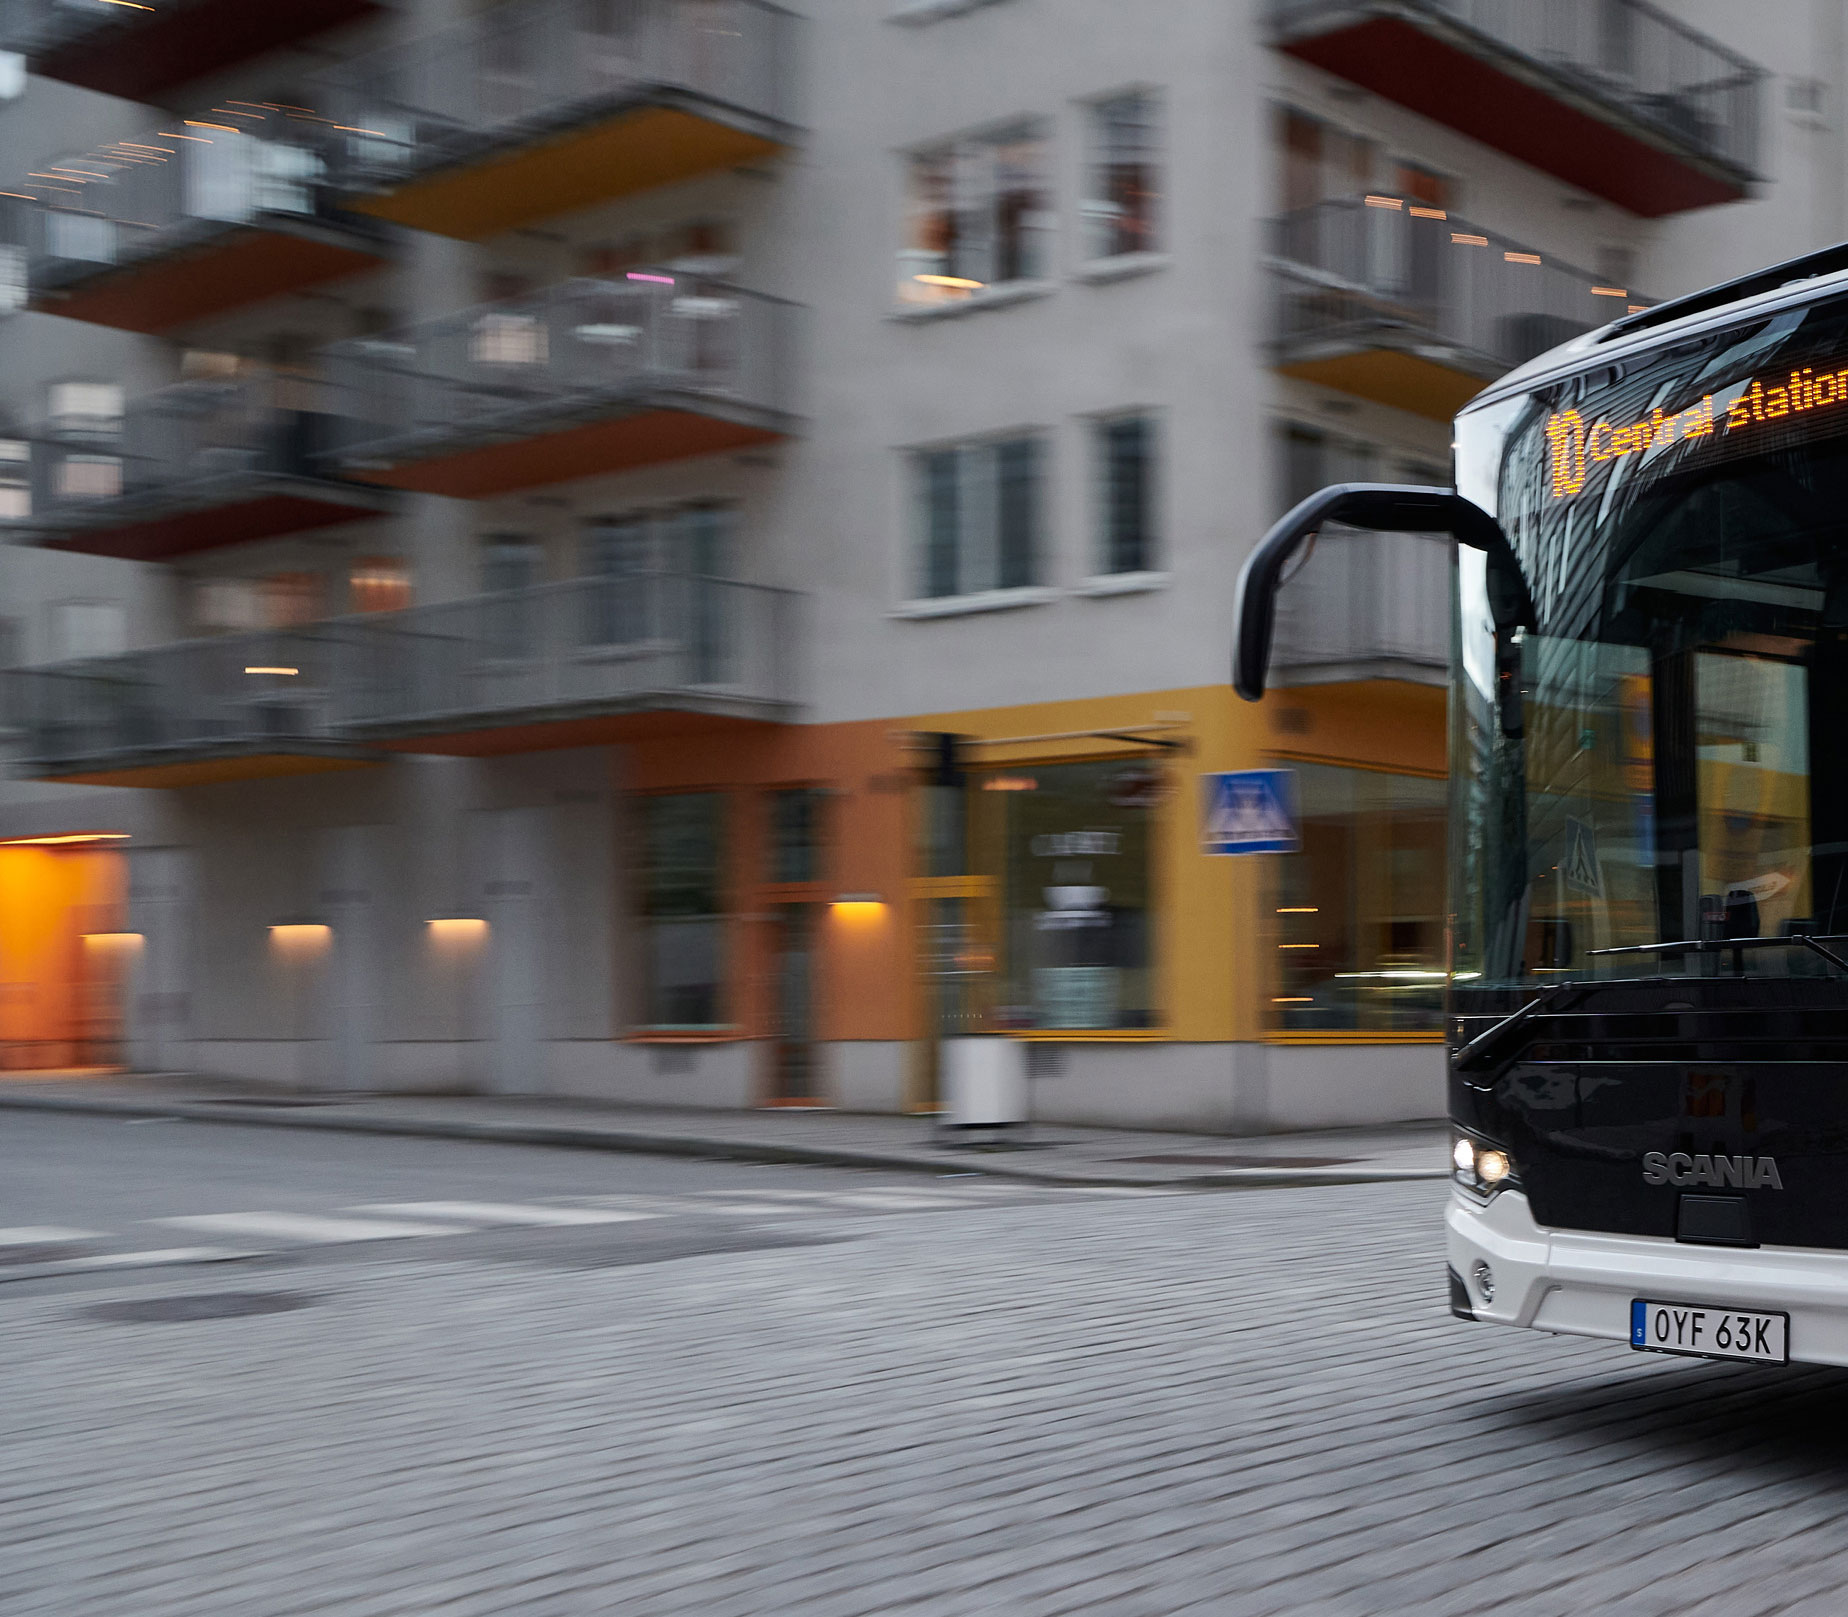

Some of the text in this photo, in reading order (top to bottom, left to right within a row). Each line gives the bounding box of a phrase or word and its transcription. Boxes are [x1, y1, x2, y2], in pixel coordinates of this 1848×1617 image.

[1546, 408, 1586, 497] 10
[1590, 394, 1713, 461] Central
[1642, 1151, 1784, 1190] SCANIA
[1636, 1328, 1643, 1337] S
[1655, 1308, 1771, 1354] OYF 63K
